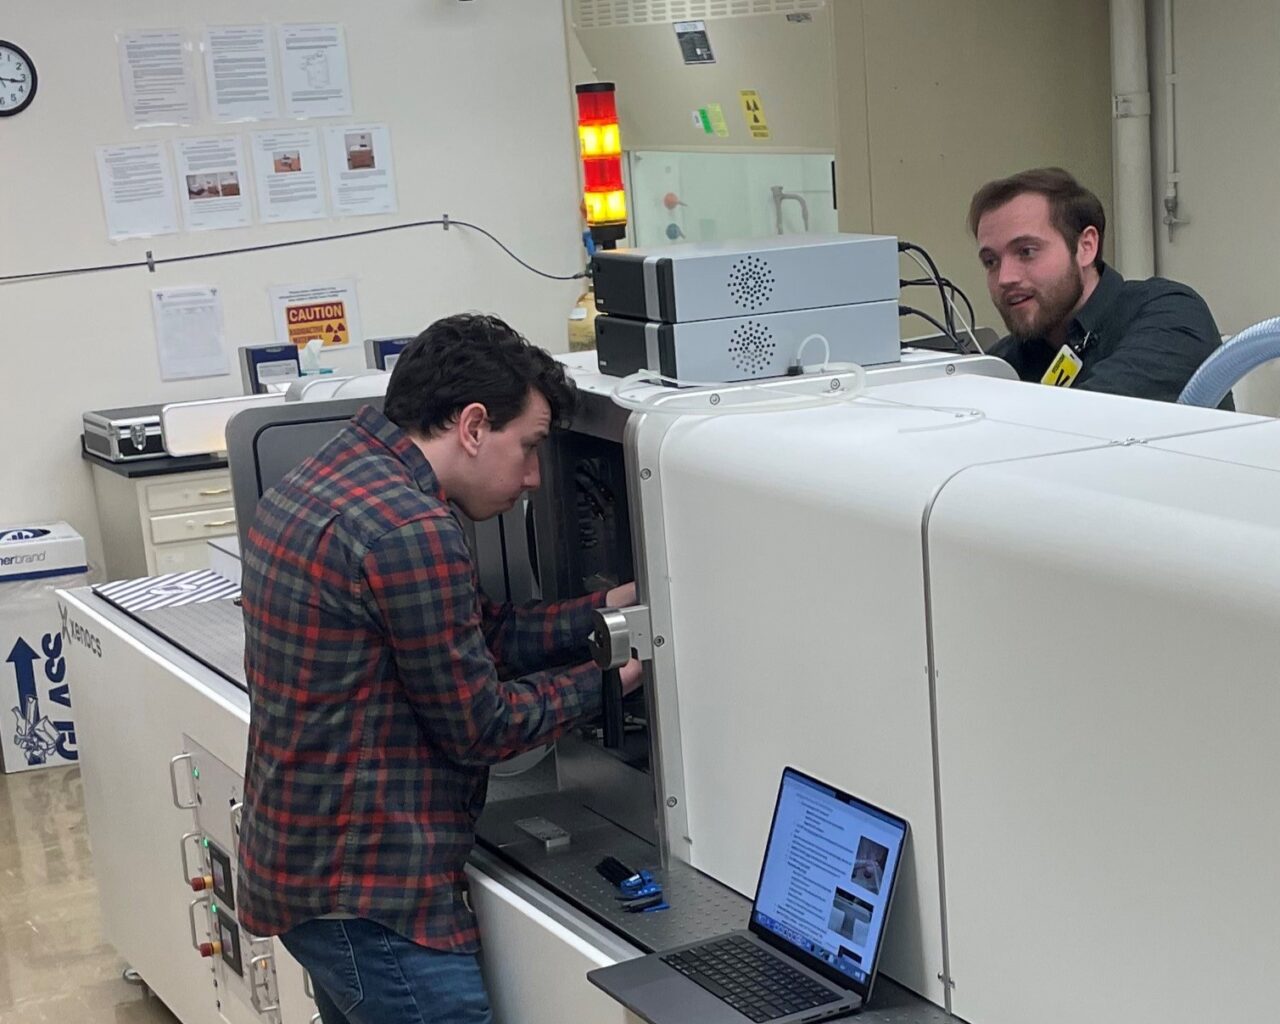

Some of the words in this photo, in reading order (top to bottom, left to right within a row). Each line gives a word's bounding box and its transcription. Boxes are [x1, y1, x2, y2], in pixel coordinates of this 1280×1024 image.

[15, 62, 22, 71] 2
[18, 85, 24, 93] 4
[10, 93, 17, 102] 5
[289, 305, 342, 322] CAUTION
[69, 620, 102, 658] xenocs
